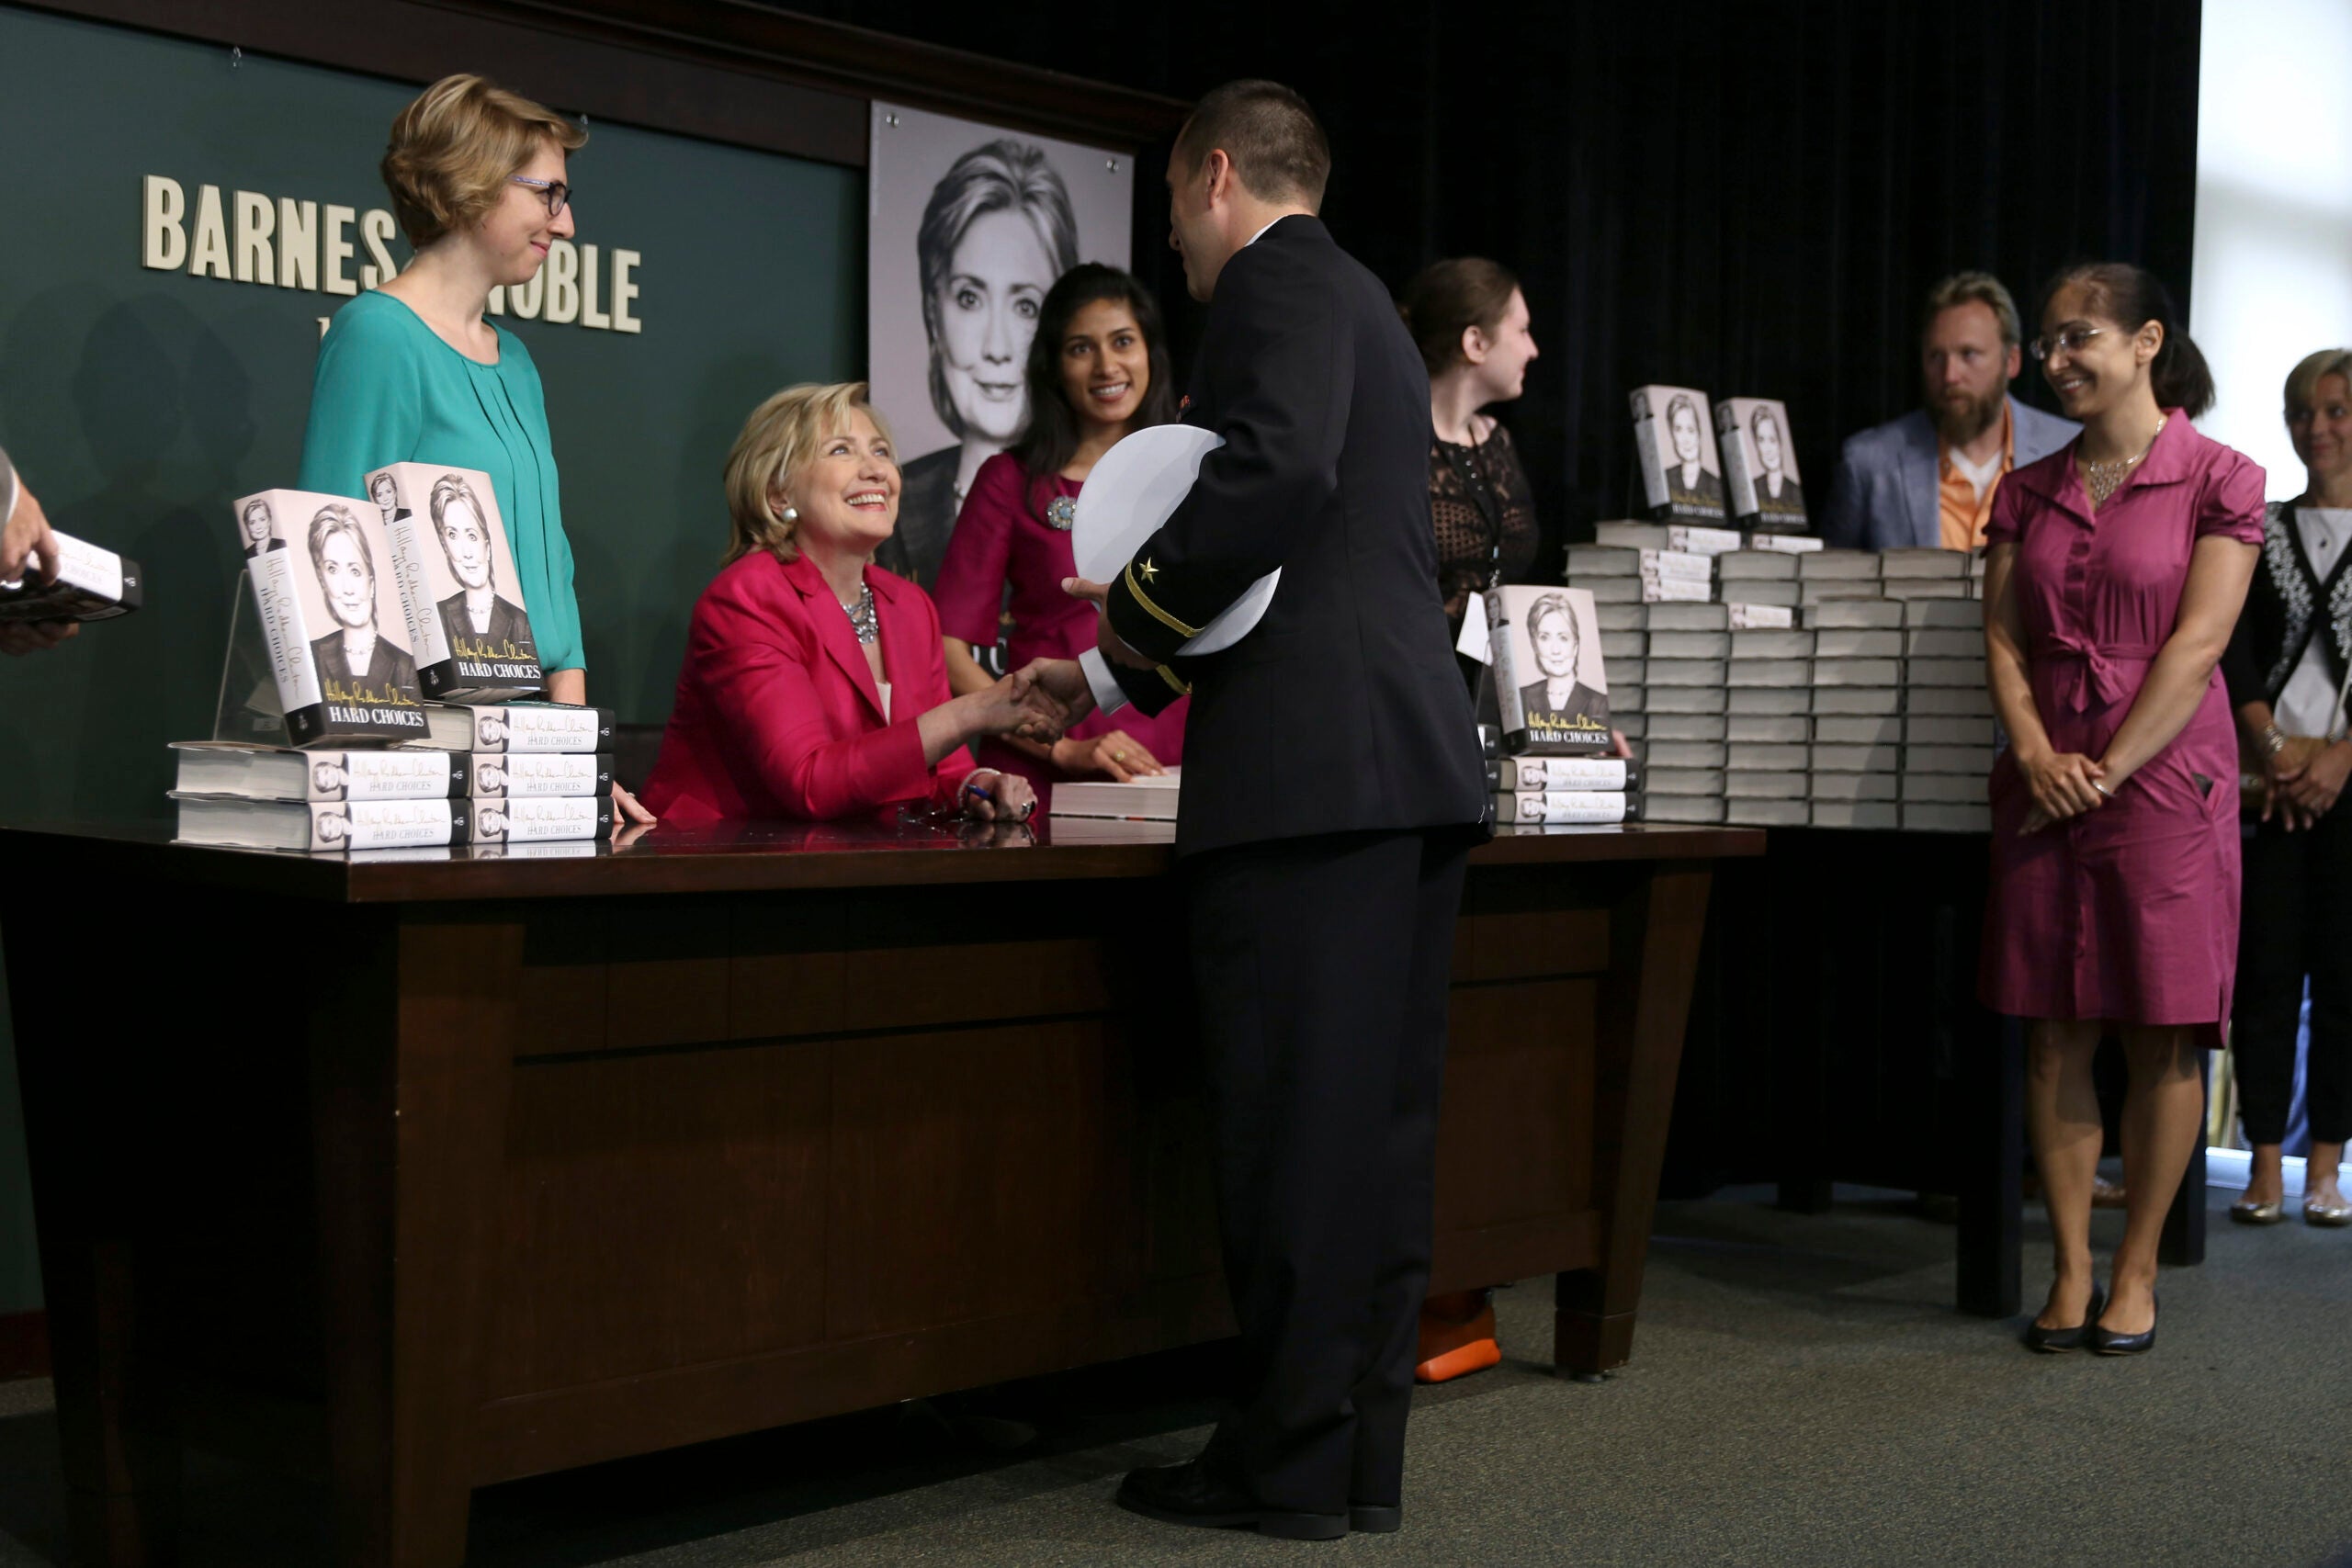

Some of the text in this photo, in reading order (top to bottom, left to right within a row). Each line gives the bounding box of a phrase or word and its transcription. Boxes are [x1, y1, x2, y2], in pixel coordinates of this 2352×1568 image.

[141, 175, 398, 296] BARNES
[391, 555, 419, 642] HARD CHOICES
[260, 588, 288, 683] HARD CHOICES
[458, 661, 541, 679] HARD CHOICES
[329, 706, 424, 727] HARD CHOICES
[527, 736, 582, 746] HARD CHOICES
[1530, 730, 1609, 744] HARD CHOICES
[369, 780, 432, 792] HARD CHOICES
[526, 782, 581, 792] HARD CHOICES
[372, 829, 435, 840] HARD CHOICES
[527, 825, 582, 835] HARD CHOICES
